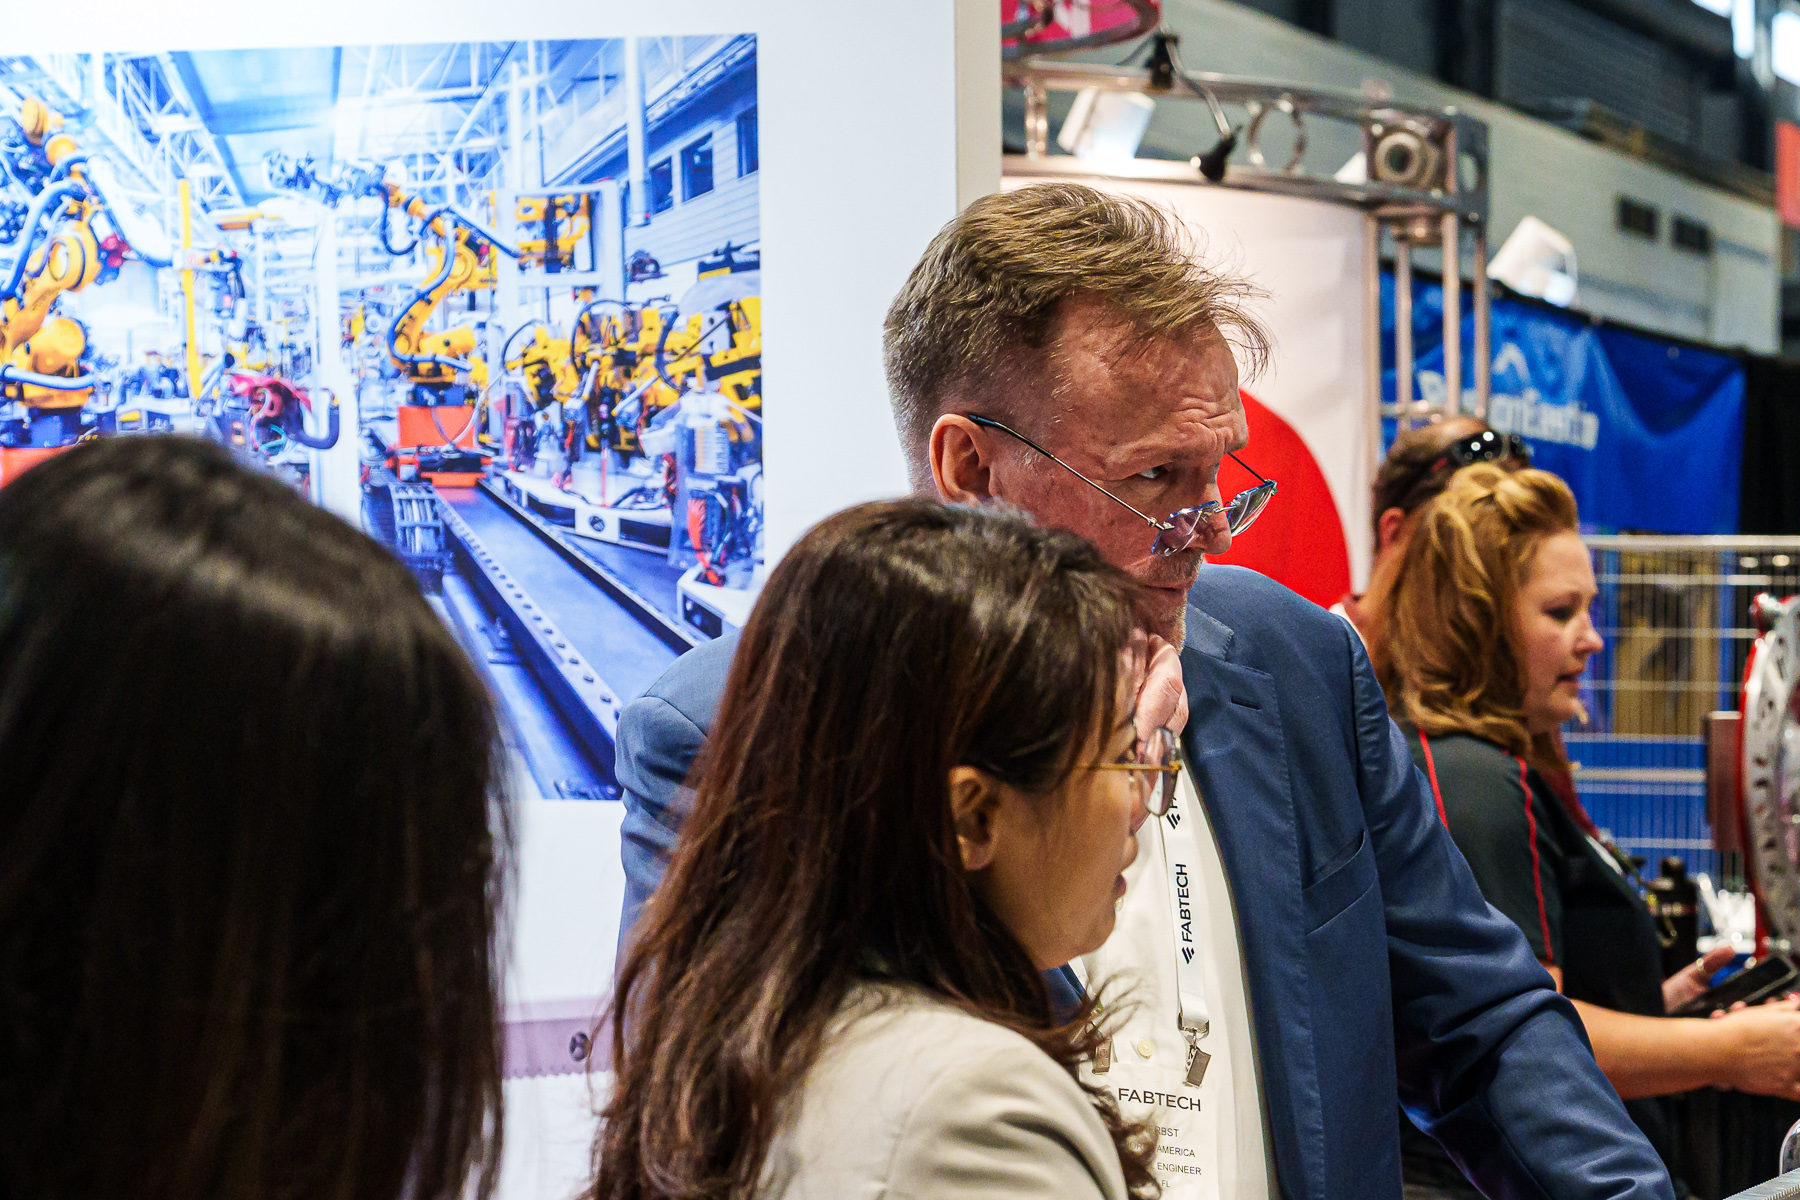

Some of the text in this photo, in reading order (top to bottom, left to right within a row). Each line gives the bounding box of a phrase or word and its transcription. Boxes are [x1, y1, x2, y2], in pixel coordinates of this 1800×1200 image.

[1175, 863, 1193, 943] FABTECH
[1118, 1087, 1202, 1112] FABTECH
[1156, 1144, 1196, 1158] AMERICA
[1157, 1162, 1202, 1175] ENGINEER
